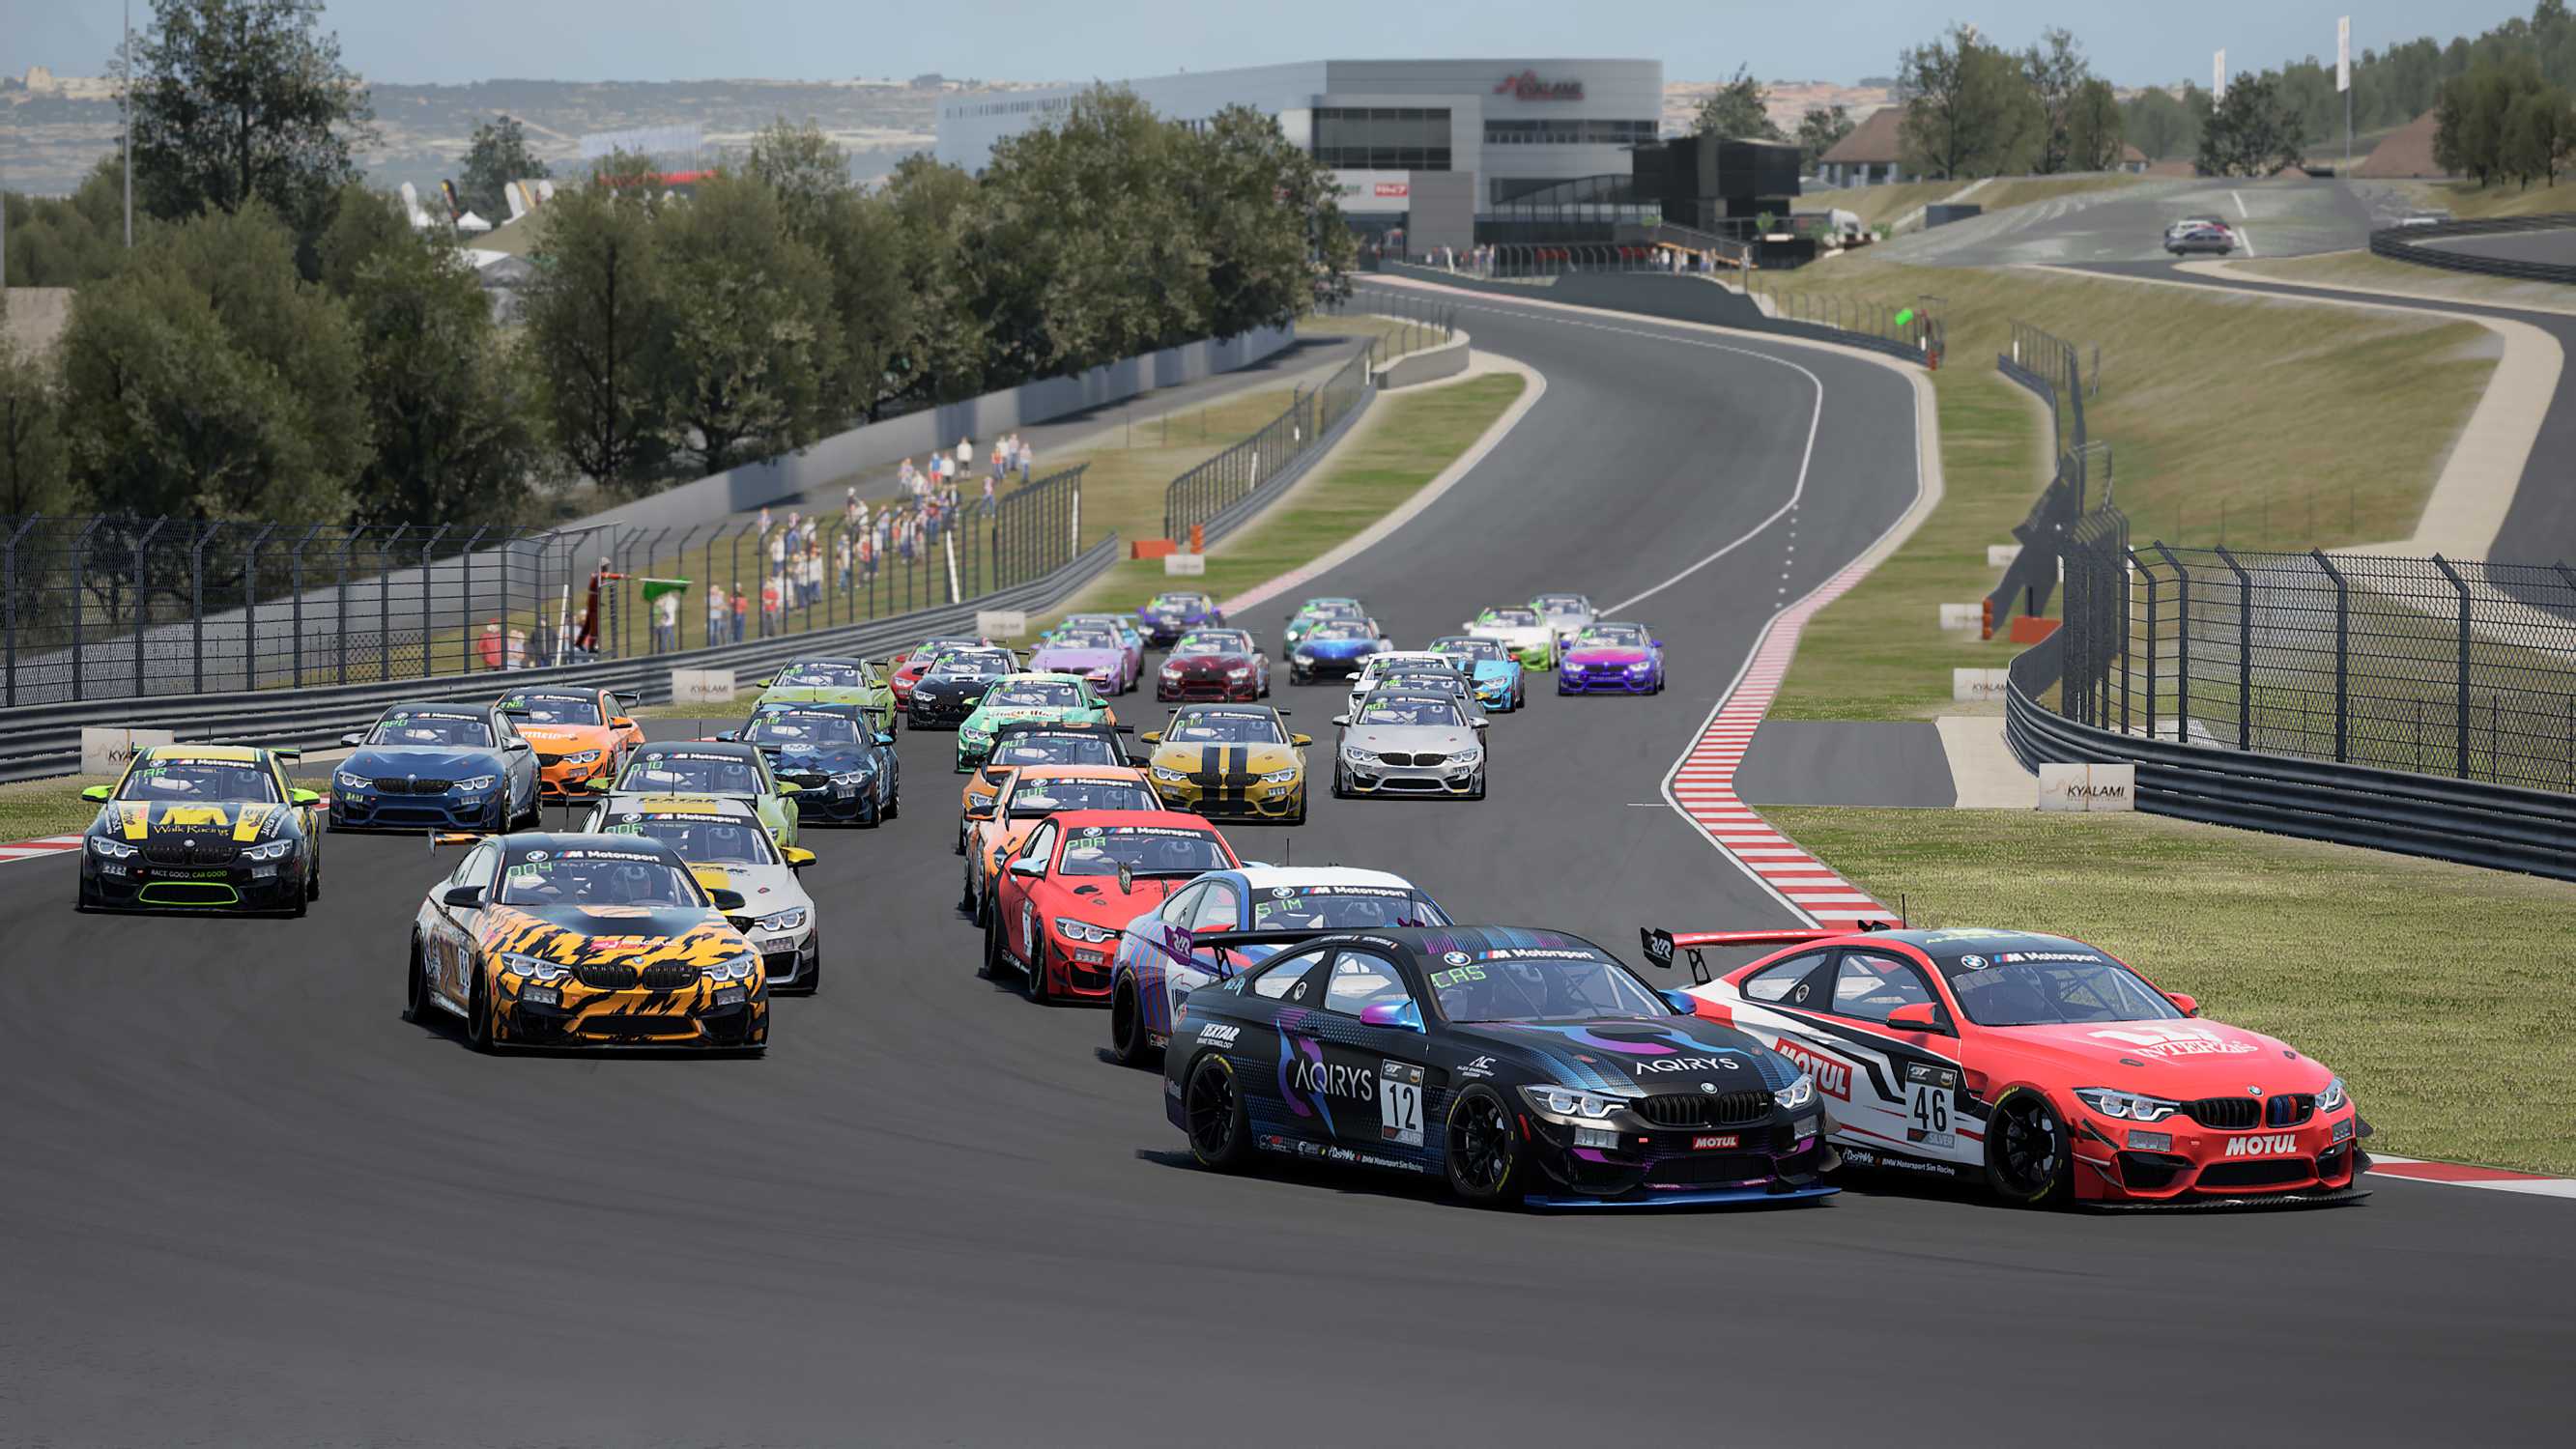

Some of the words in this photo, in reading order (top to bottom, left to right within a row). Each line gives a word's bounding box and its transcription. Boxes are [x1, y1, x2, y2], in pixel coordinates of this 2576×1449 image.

[197, 759, 254, 768] Motorsport
[2068, 785, 2125, 796] KYALAMI
[677, 813, 741, 824] Motorsport
[1137, 828, 1201, 838] Motorsport
[587, 850, 660, 862] Motorsport
[1333, 886, 1408, 897] Motorsport
[1514, 949, 1594, 960] Motorsport
[2025, 952, 2102, 962] Motorsport
[1199, 1023, 1241, 1041] TEXTAR
[1637, 1058, 1739, 1075] AQIRYS
[1295, 1059, 1373, 1101] AQIRYS
[1389, 1084, 1417, 1129] 12
[1914, 1087, 1947, 1132] 46
[1695, 1137, 1737, 1148] MOTUL
[1929, 1131, 1953, 1147] SILVER
[2225, 1134, 2297, 1156] MOTUL
[1896, 1159, 1926, 1171] Motorsport
[1926, 1163, 1936, 1172] Sim
[1936, 1165, 1955, 1176] Racing
